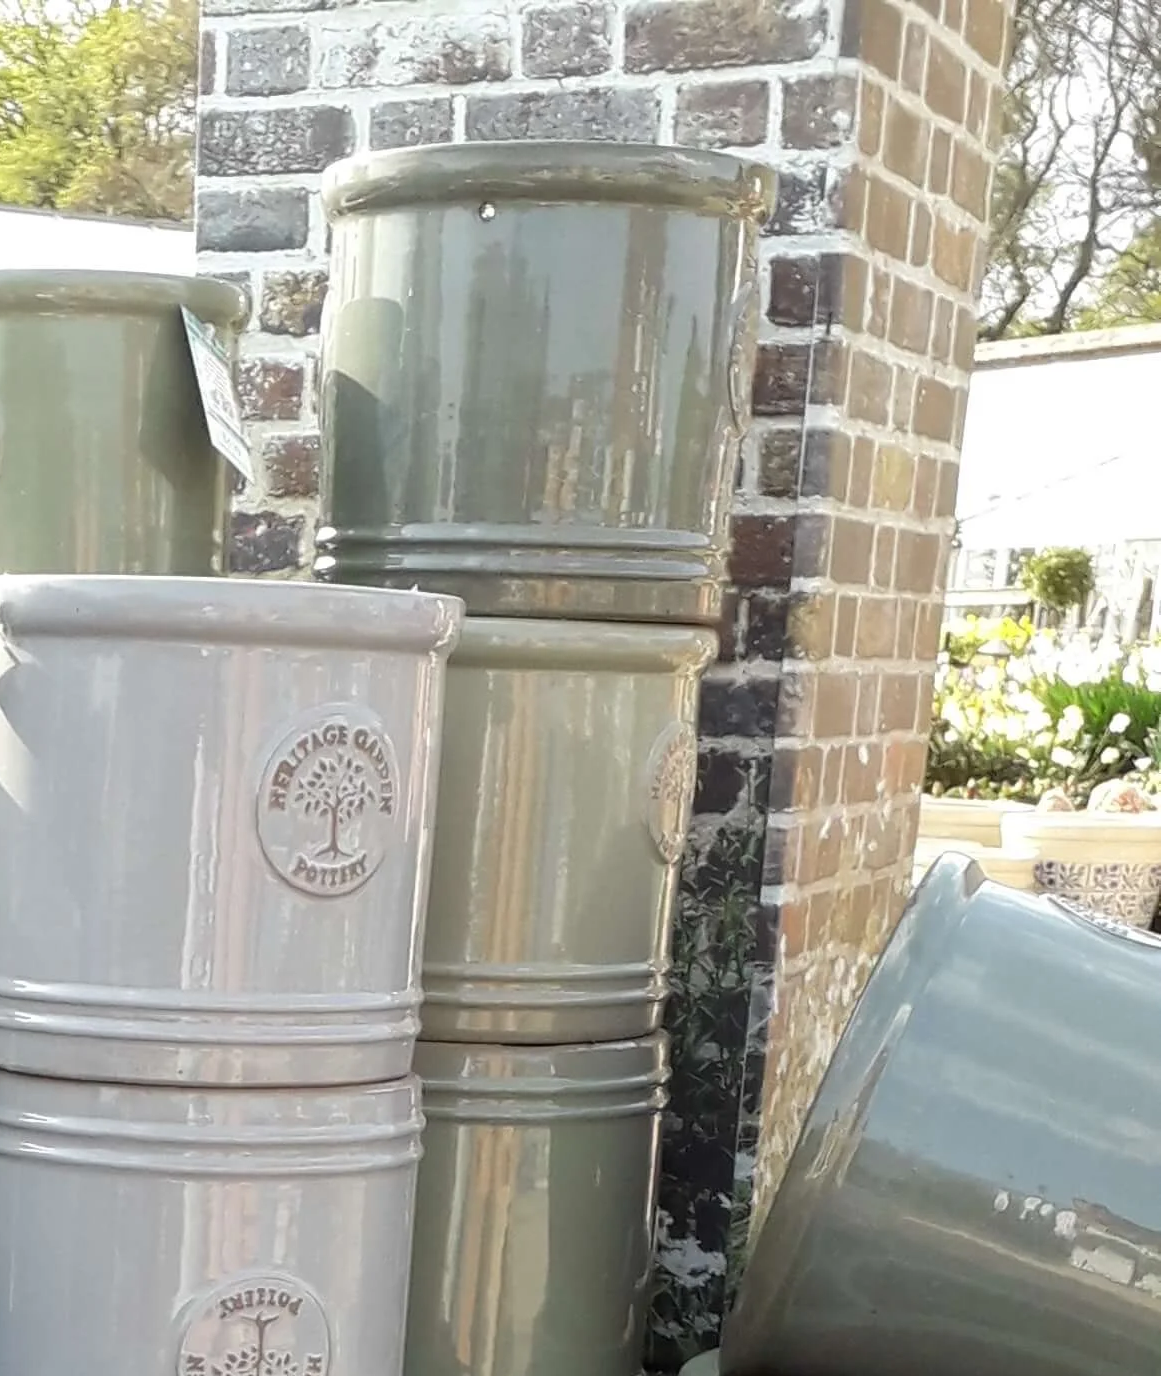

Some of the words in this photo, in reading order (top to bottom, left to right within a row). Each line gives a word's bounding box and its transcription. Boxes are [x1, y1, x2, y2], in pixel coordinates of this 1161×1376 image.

[269, 724, 348, 811] HERITAGE
[354, 728, 393, 815] GARDEN
[292, 853, 367, 886] POTTERY
[219, 1287, 304, 1319] POTTERY
